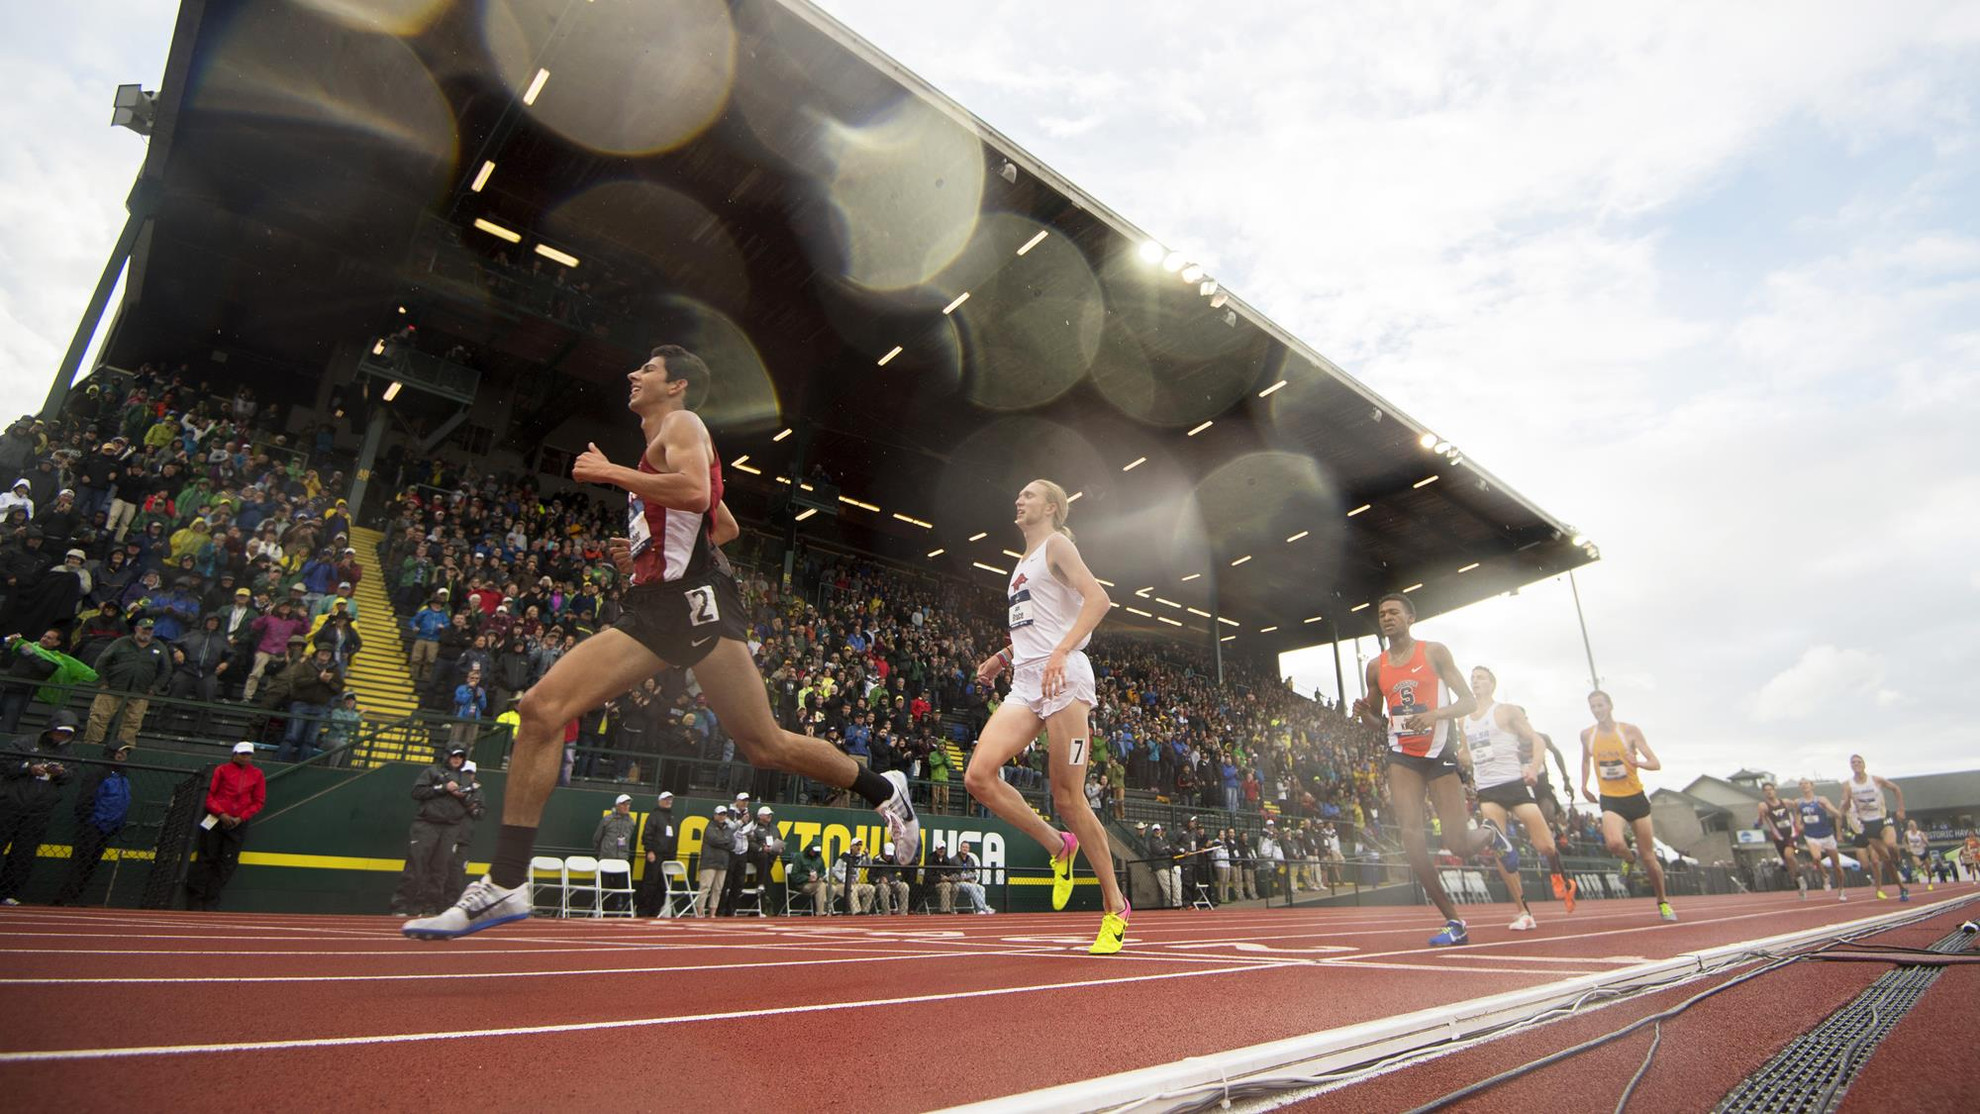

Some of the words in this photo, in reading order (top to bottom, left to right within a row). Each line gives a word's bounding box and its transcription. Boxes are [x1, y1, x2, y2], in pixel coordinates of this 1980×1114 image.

[692, 590, 714, 622] 2
[1401, 686, 1415, 706] S
[1074, 740, 1083, 763] 7
[933, 829, 1005, 885] USA
